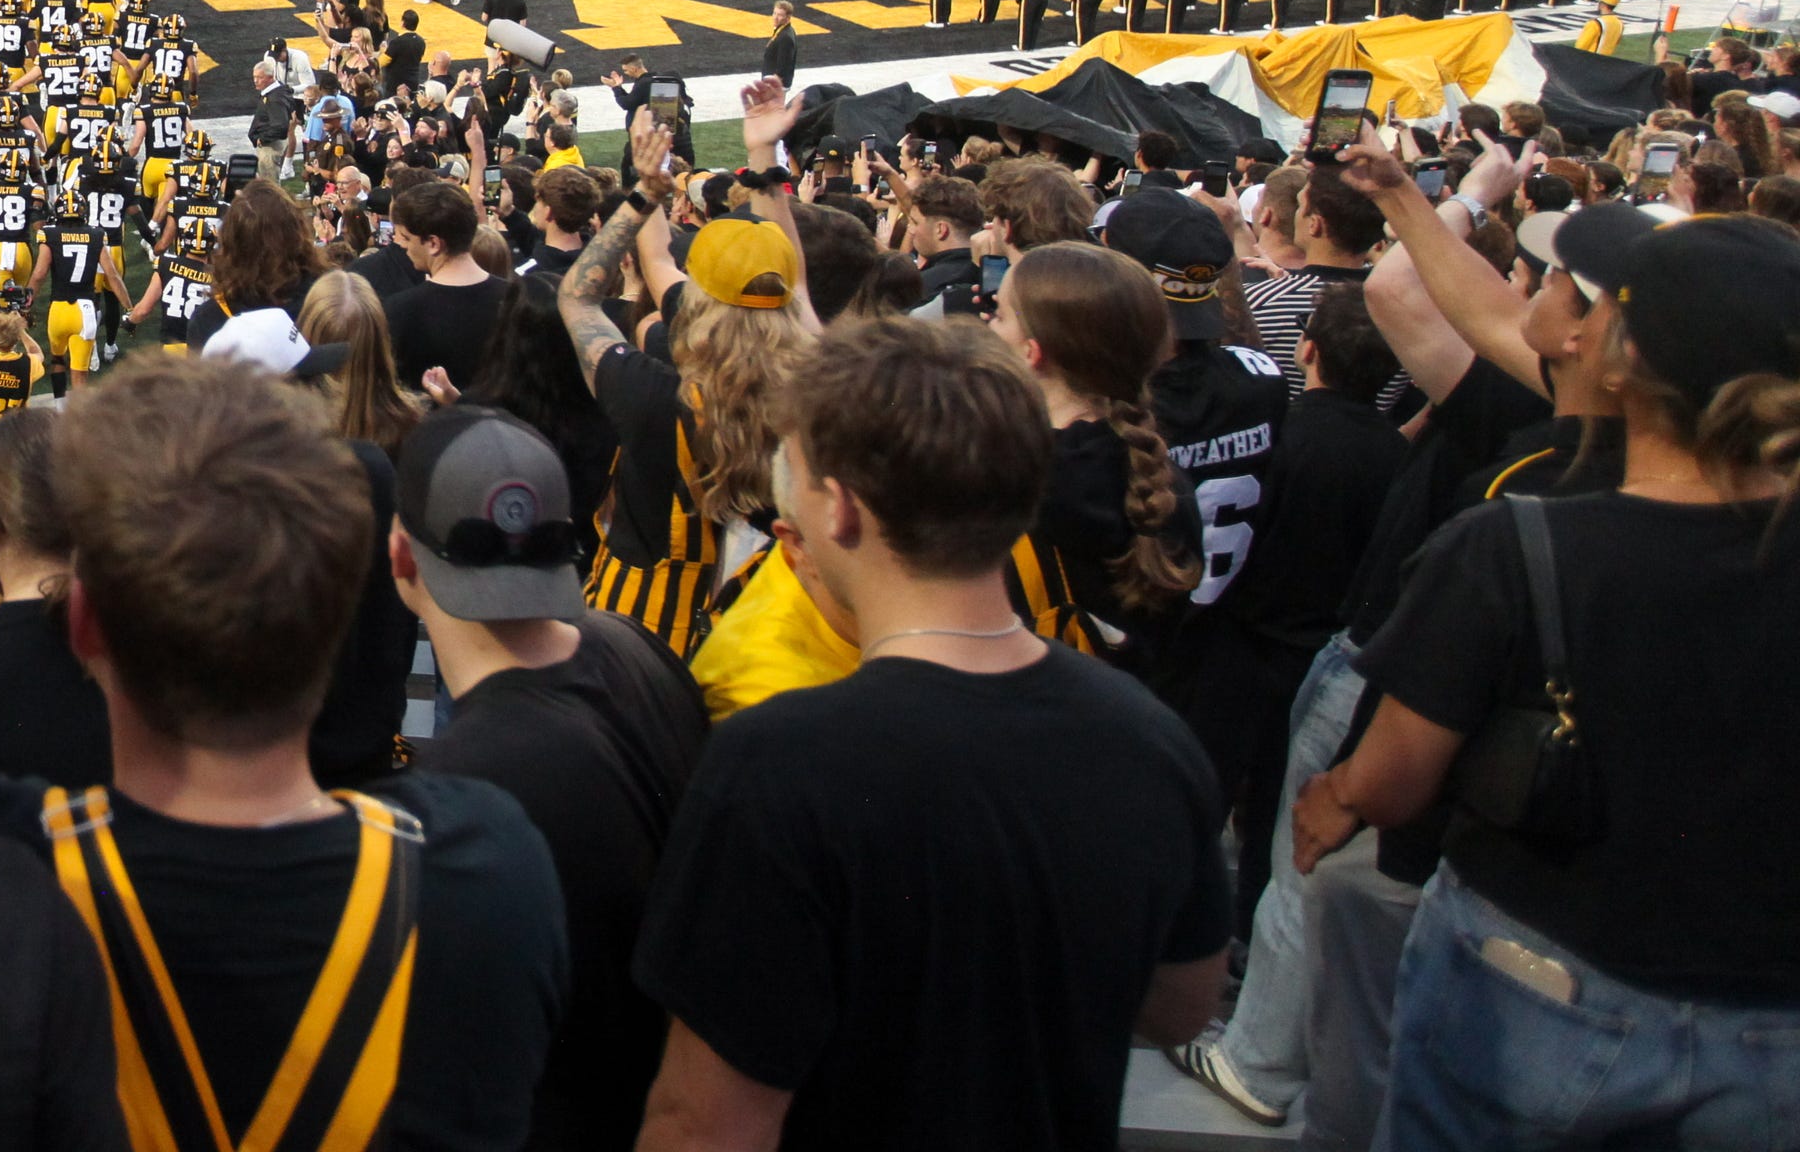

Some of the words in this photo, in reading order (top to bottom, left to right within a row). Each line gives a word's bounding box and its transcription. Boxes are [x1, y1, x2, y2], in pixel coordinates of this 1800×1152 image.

[41, 7, 67, 32] 14
[127, 15, 150, 24] WALLACE
[86, 38, 111, 47] WILLIAMS
[124, 22, 147, 50] 11
[48, 58, 77, 67] TELANDER
[155, 48, 186, 78] 16
[45, 67, 80, 95] 25
[18, 138, 26, 146] JR
[152, 117, 183, 148] 19
[87, 191, 124, 228] 18
[186, 205, 217, 215] JACKSON
[61, 233, 90, 243] HOWARD
[62, 244, 88, 283] 7
[1190, 475, 1260, 605] 6
